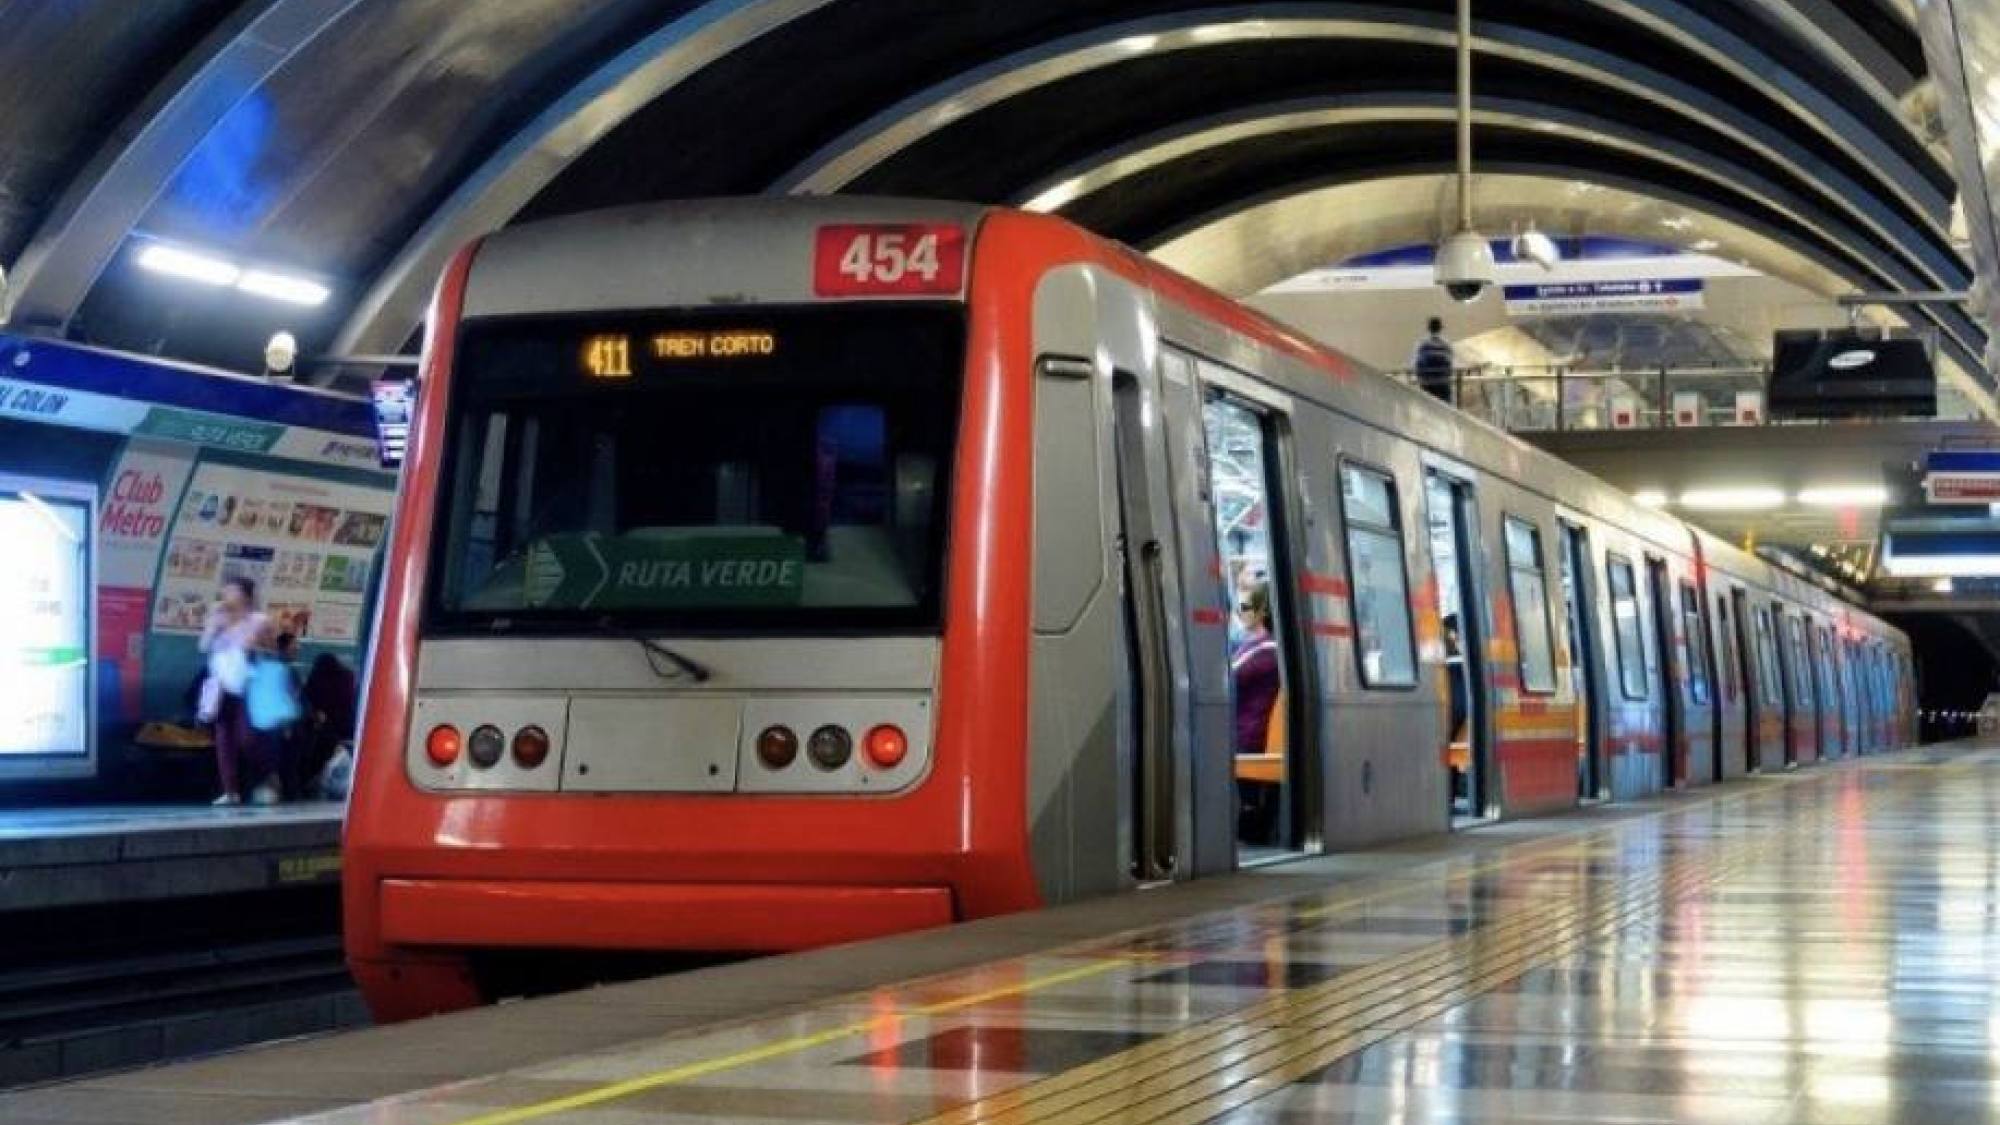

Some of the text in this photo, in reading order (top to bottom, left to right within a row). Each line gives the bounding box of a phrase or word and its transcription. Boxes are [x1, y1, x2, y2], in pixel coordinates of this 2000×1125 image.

[839, 233, 939, 283] 454
[588, 338, 632, 377] 411
[655, 334, 773, 357] TREN CORTO
[113, 469, 164, 504] Club
[101, 503, 165, 538] Metro
[619, 560, 798, 586] RUTA VERDE
